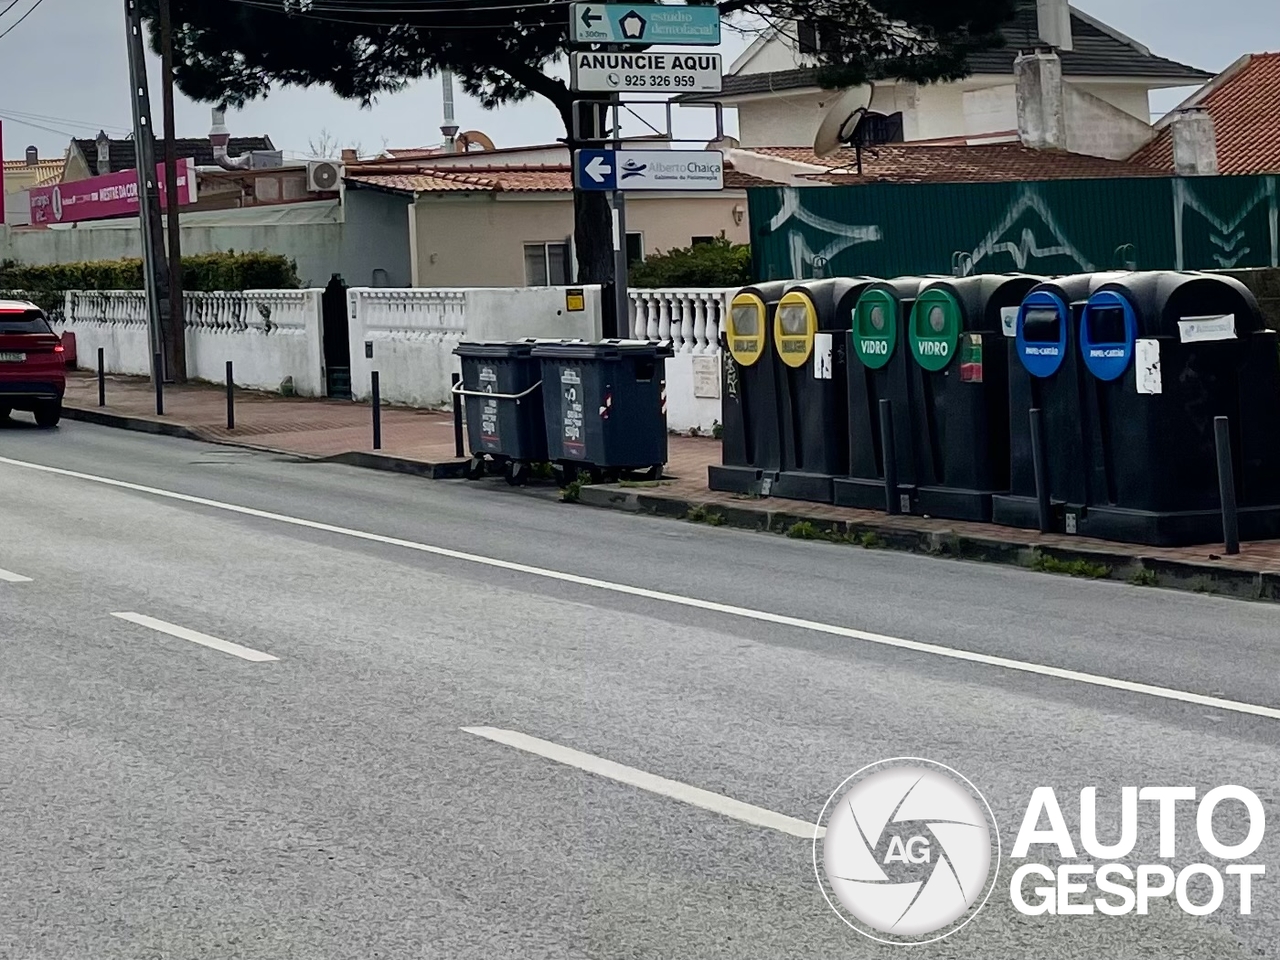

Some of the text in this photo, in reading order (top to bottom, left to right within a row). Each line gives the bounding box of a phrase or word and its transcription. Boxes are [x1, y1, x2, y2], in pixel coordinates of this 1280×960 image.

[580, 55, 717, 71] ANUNCIE AQUI
[625, 75, 695, 87] 925 326 959
[860, 340, 888, 355] VIDRO
[918, 340, 949, 356] VIDRO
